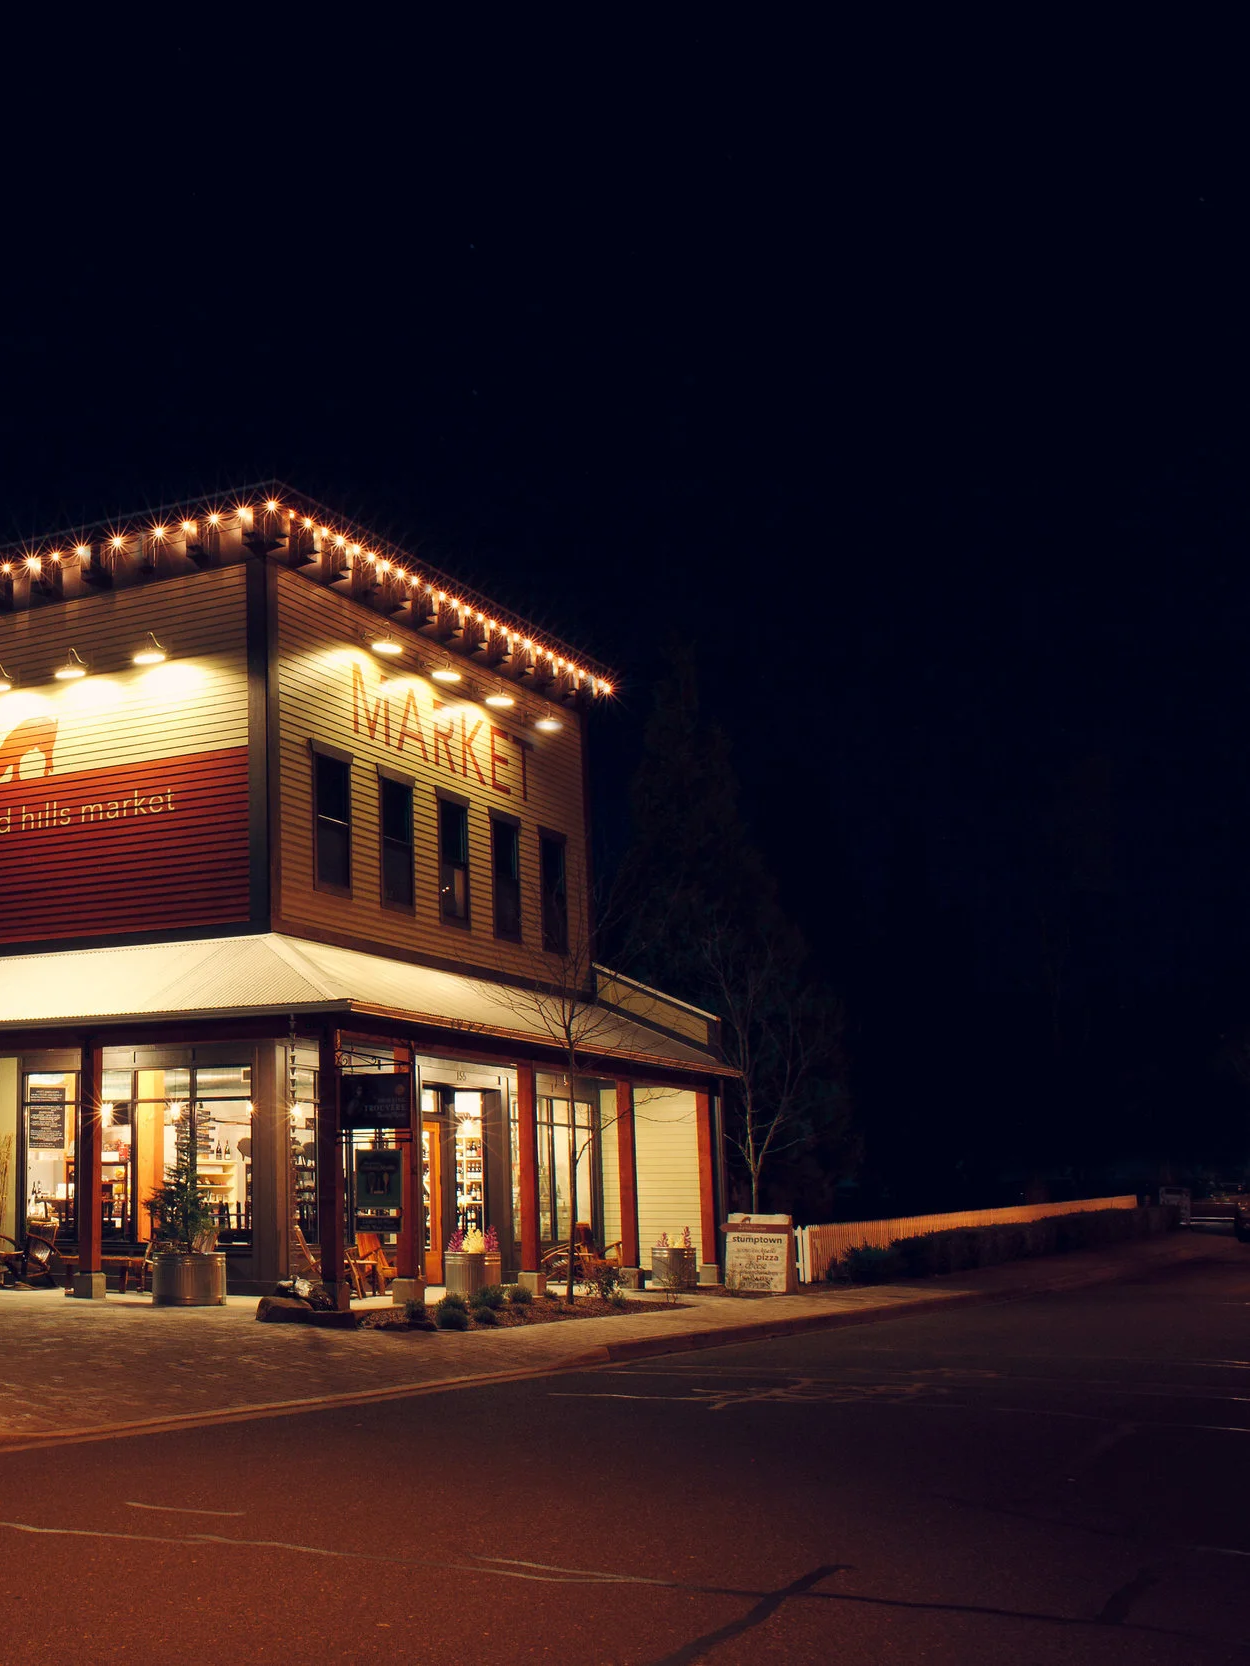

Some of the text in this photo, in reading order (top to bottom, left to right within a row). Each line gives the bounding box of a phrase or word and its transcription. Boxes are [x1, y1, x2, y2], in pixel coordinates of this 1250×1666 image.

[352, 661, 534, 801] MARKET
[21, 801, 71, 831] hills
[81, 788, 175, 823] market
[456, 1070, 467, 1081] 155
[732, 1236, 783, 1244] stumptown
[756, 1253, 779, 1262] pizza
